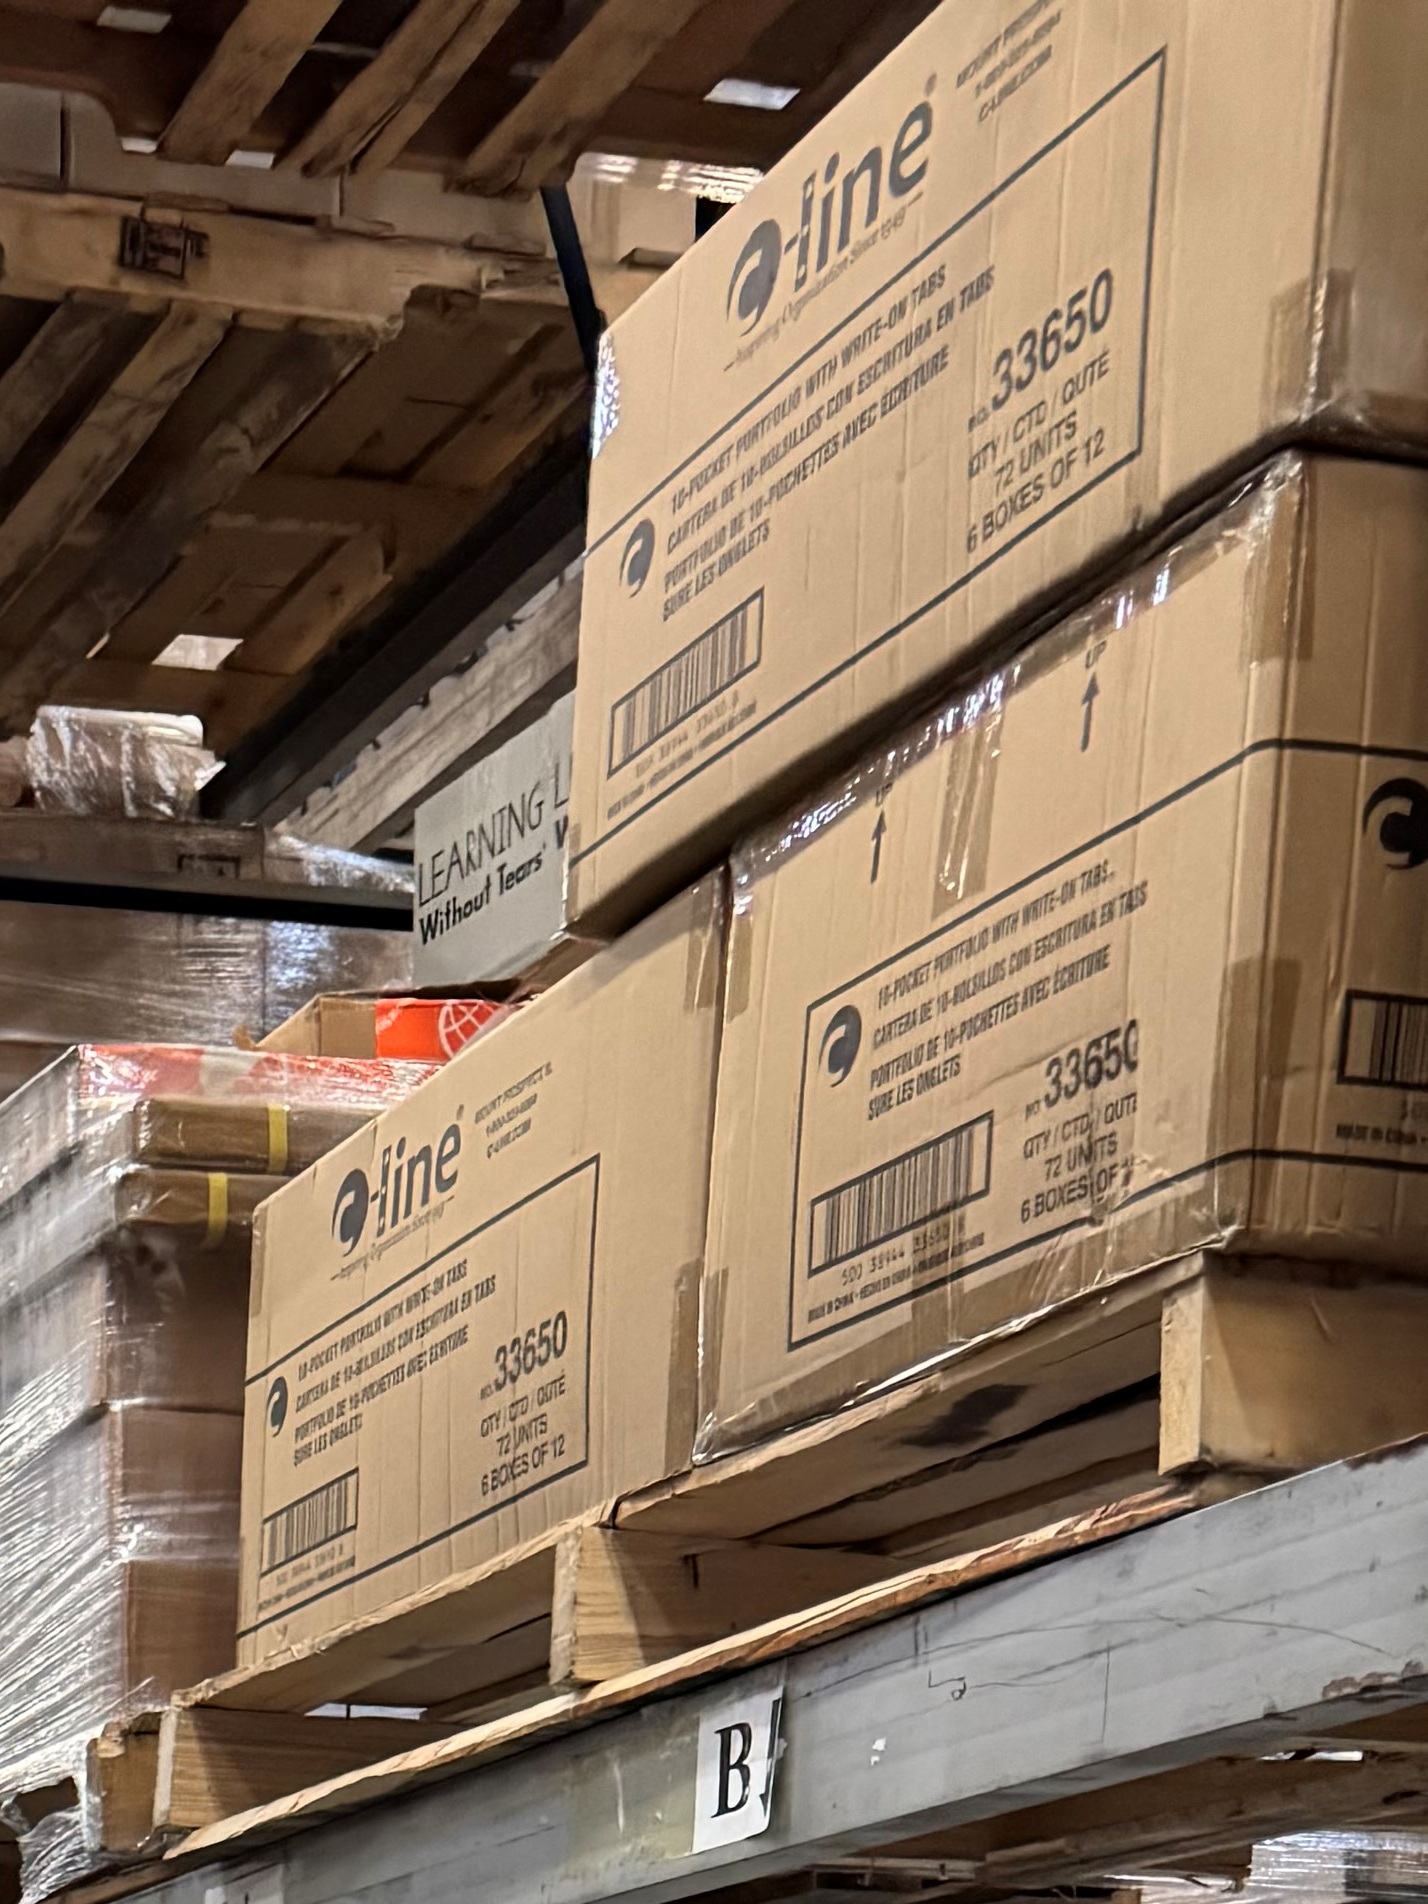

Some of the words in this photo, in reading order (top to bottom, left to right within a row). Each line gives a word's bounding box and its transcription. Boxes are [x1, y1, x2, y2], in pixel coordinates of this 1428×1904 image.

[805, 353, 837, 401] WITH
[840, 292, 907, 372] WRITE-ON
[911, 260, 946, 312] TABS
[856, 313, 932, 399] ESCRITURA
[936, 295, 954, 333] EN
[991, 259, 1115, 416] 33650
[966, 521, 977, 556] 6
[982, 469, 1044, 543] BOXES
[1049, 444, 1077, 492] OF
[1083, 423, 1105, 469] 12
[993, 455, 1014, 499] 72
[1019, 406, 1077, 477] UNITS
[694, 561, 714, 596] LES
[419, 781, 545, 908] LEARNING
[419, 874, 492, 946] Without
[992, 910, 1018, 944] WITH
[1021, 876, 1076, 928] WRITE-ON
[896, 1076, 914, 1106] LES
[1044, 1016, 1139, 1109] 33650
[1023, 1129, 1049, 1160] QTY
[1044, 1153, 1061, 1181] 72
[1066, 1130, 1118, 1173] UNITS
[1020, 1197, 1030, 1224] 6
[1034, 1174, 1088, 1218] BOXES
[1095, 1162, 1118, 1195] OF
[494, 1306, 568, 1394] 33650
[480, 1471, 489, 1498] 6
[531, 1439, 548, 1471] OF
[551, 1431, 565, 1460] 12
[495, 1430, 510, 1459] 72
[512, 1408, 547, 1451] UNITS
[710, 1722, 752, 1818] B
